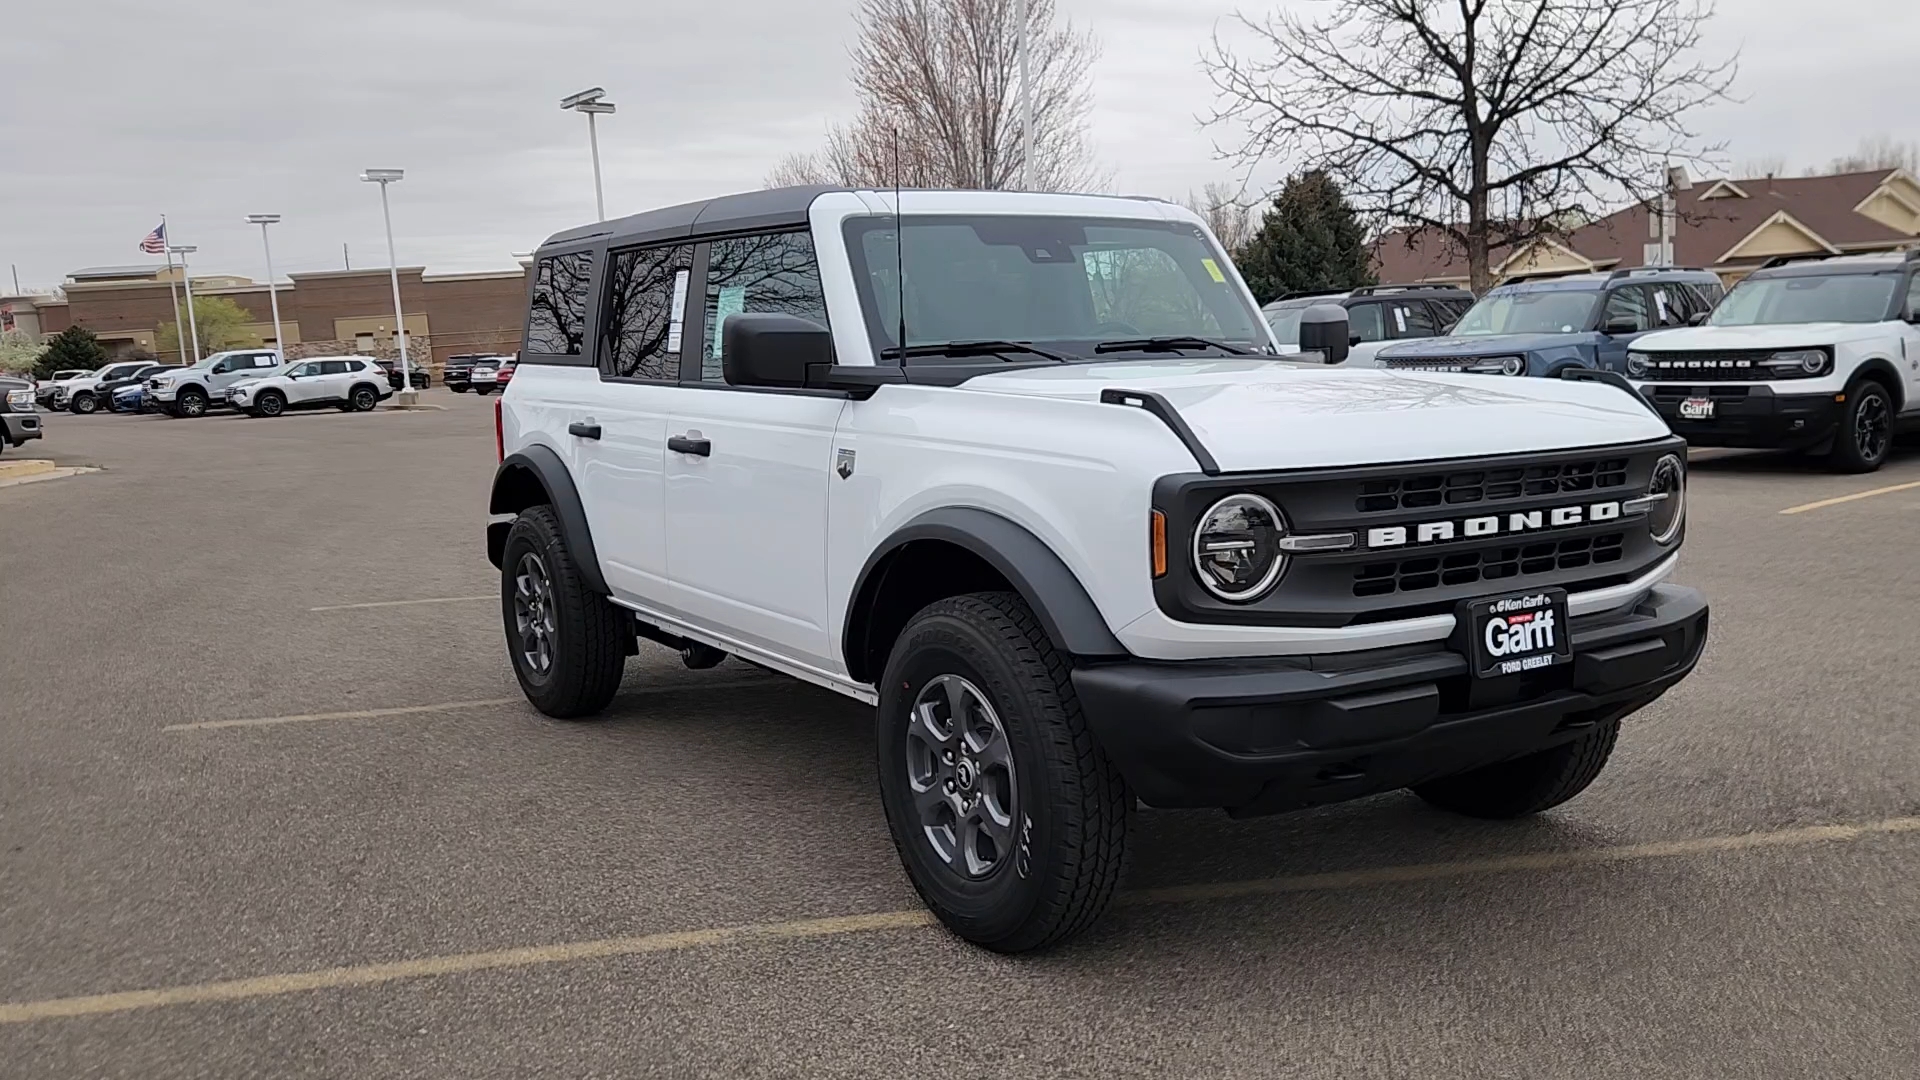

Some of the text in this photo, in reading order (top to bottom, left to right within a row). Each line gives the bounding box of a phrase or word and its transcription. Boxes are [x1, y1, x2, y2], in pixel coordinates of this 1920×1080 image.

[1680, 401, 1714, 415] Garff
[1367, 501, 1620, 548] BRONCO
[1505, 599, 1522, 612] Ken
[1522, 593, 1545, 609] Garff
[1485, 609, 1555, 657] Garff
[1501, 654, 1553, 674] FORD GREELEY
